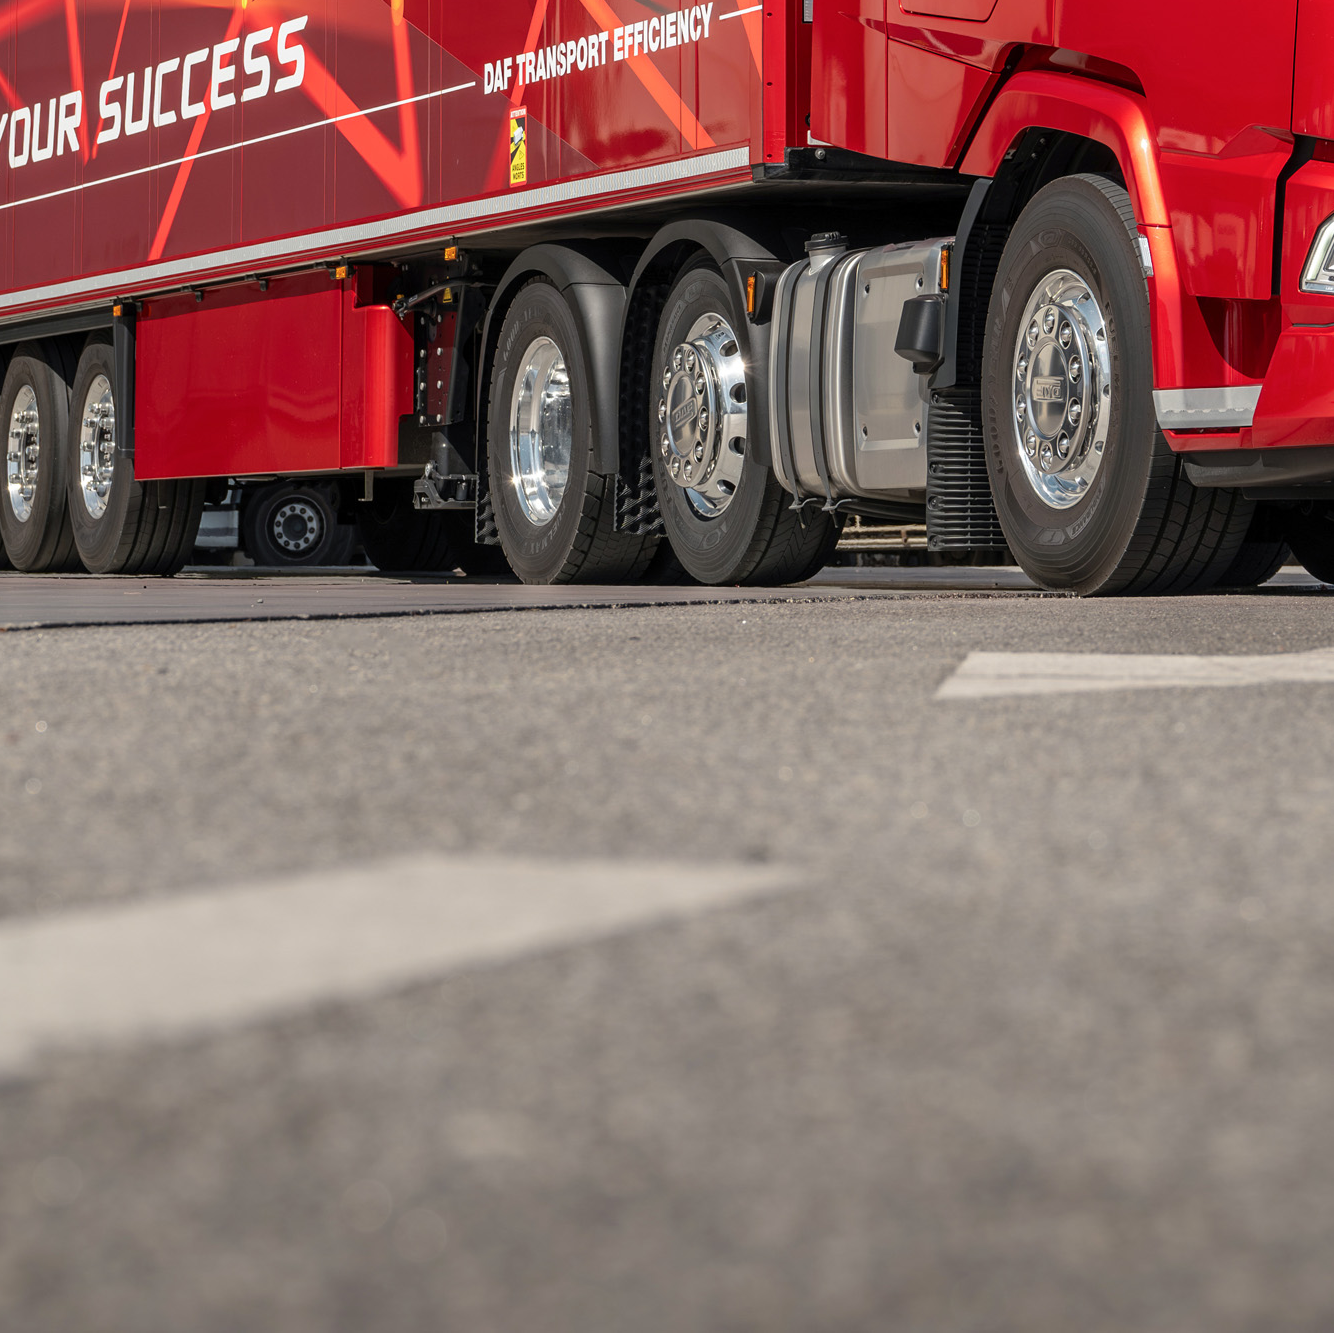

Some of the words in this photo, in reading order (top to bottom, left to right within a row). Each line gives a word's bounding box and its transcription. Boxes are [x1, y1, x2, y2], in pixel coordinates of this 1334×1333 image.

[96, 14, 309, 145] SUCCESS
[483, 54, 513, 95] DAF
[515, 31, 609, 86] TRANSPORT
[613, 2, 714, 62] EFFICIENCY
